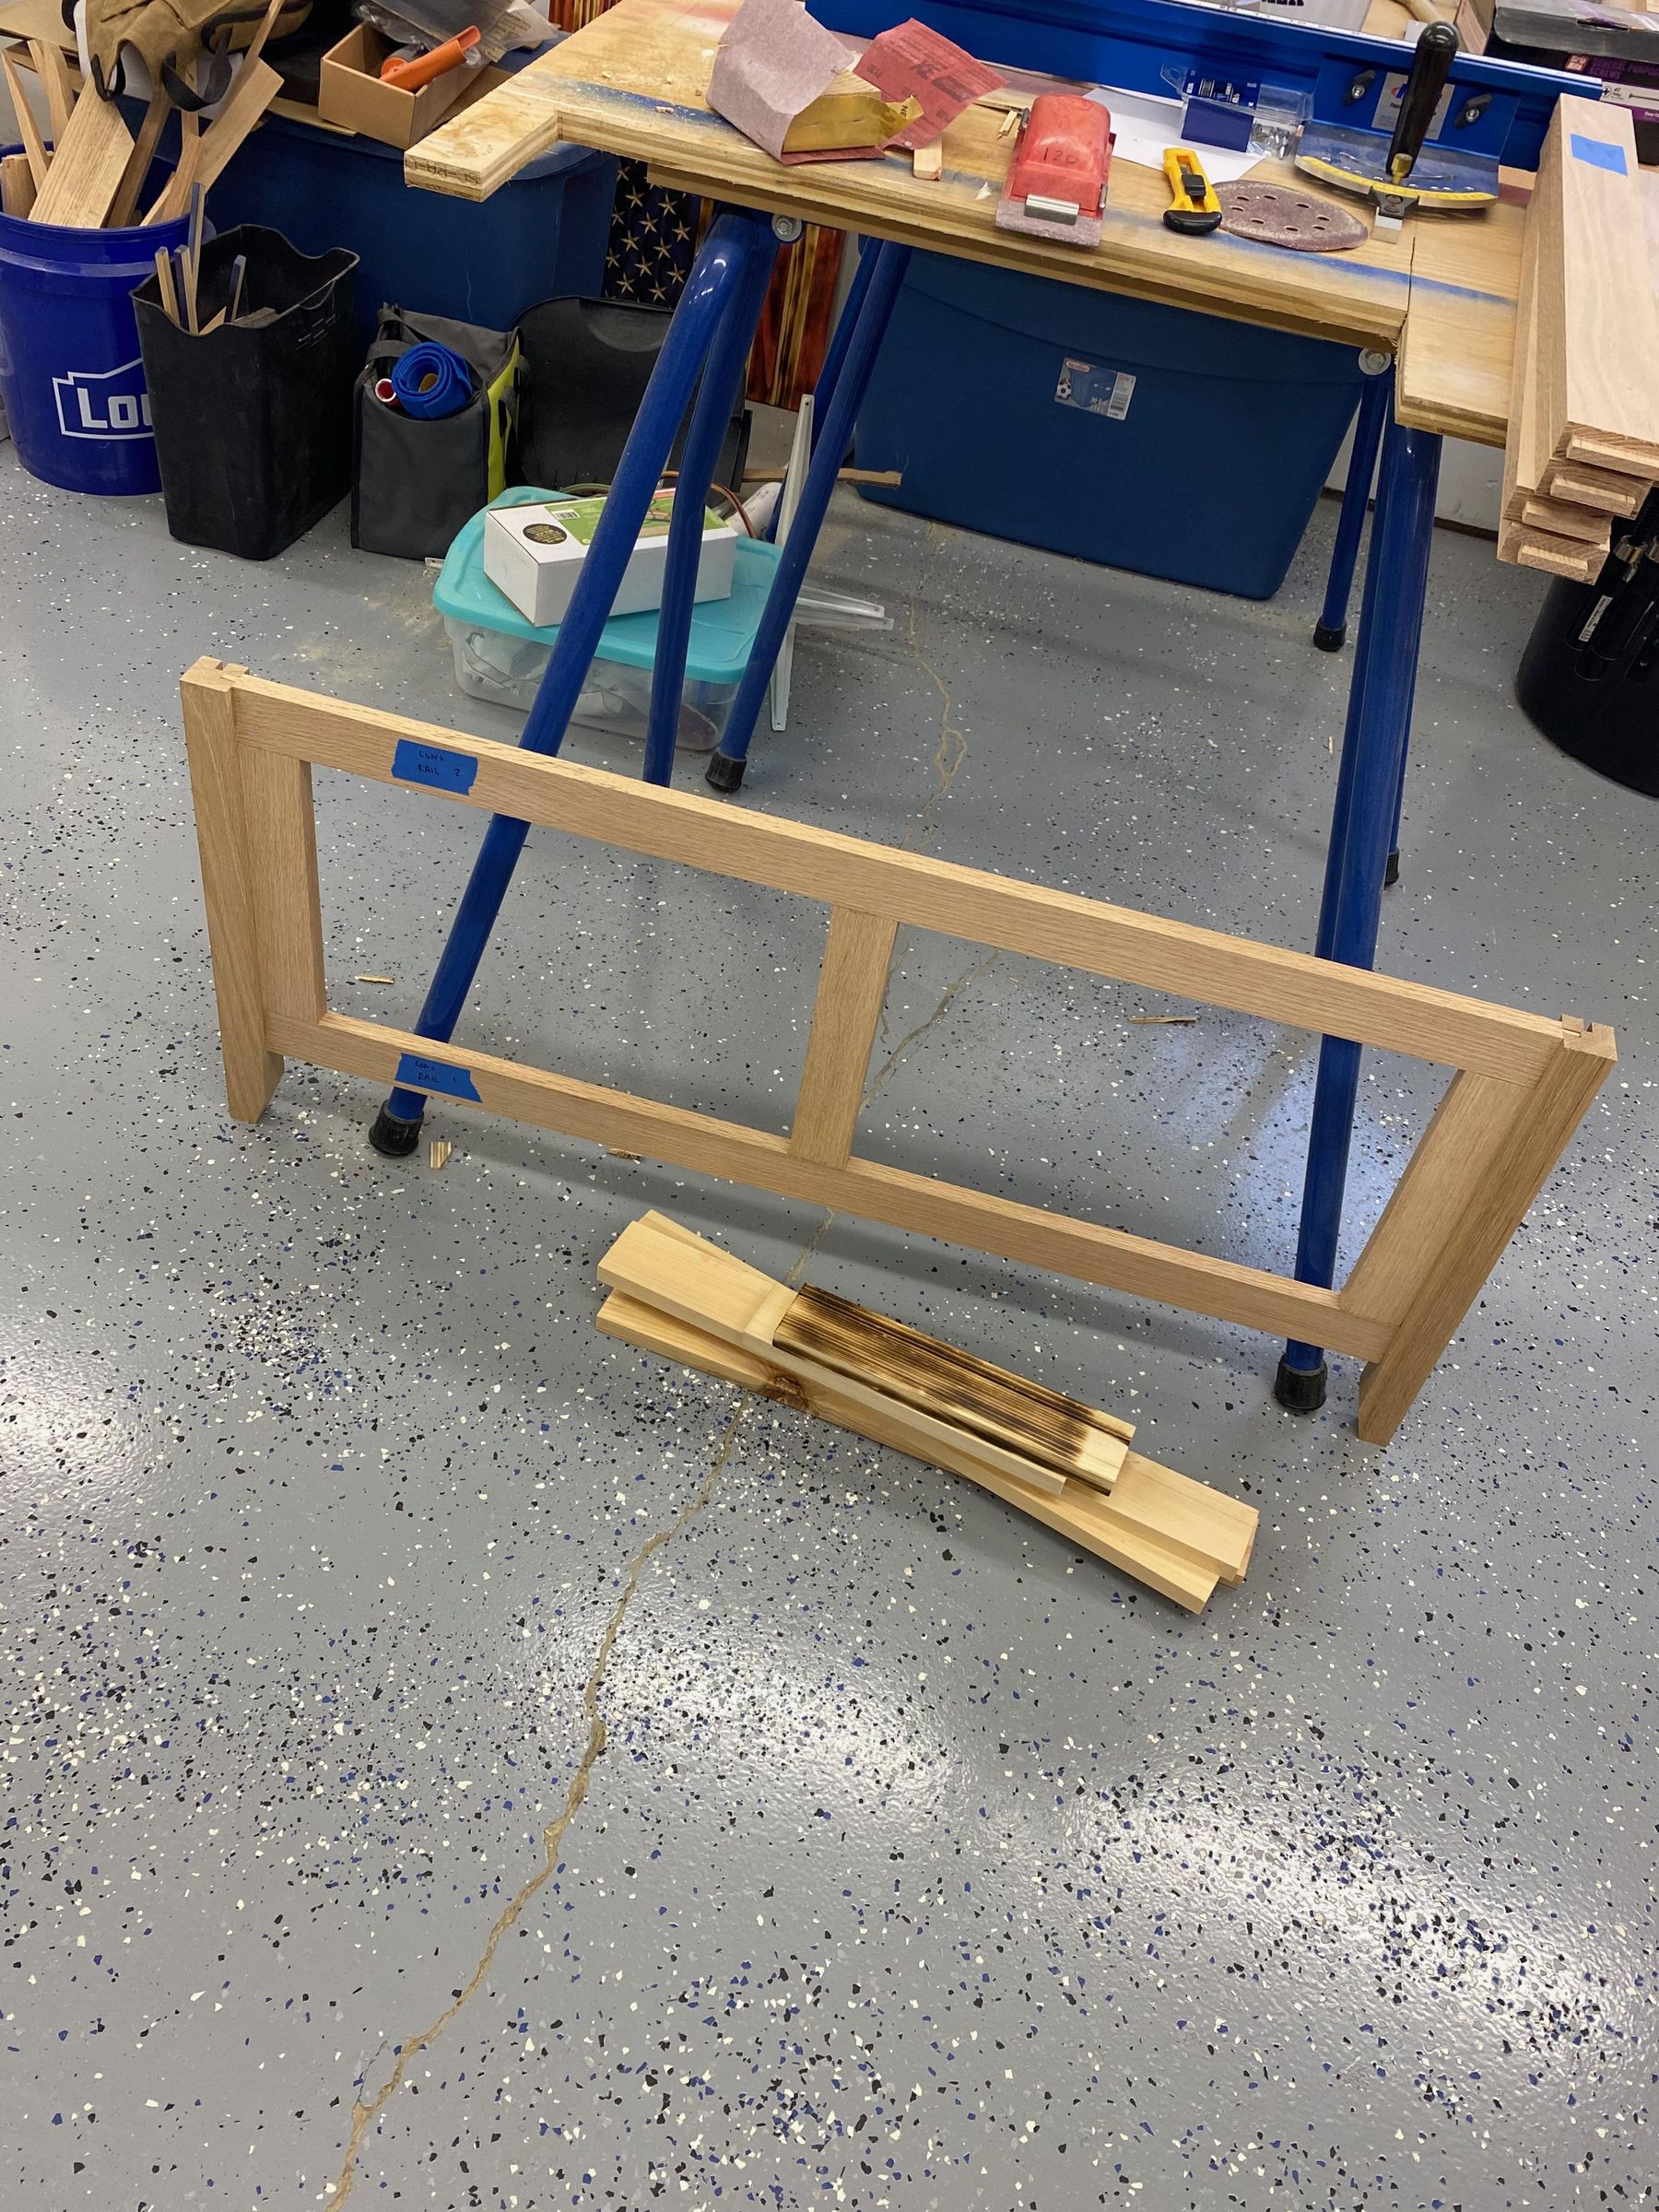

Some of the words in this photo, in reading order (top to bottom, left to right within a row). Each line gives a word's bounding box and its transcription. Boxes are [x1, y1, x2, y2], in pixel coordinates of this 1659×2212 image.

[1043, 147, 1078, 164] 120
[418, 763, 440, 775] RAIL
[418, 1072, 442, 1084] RAIL
